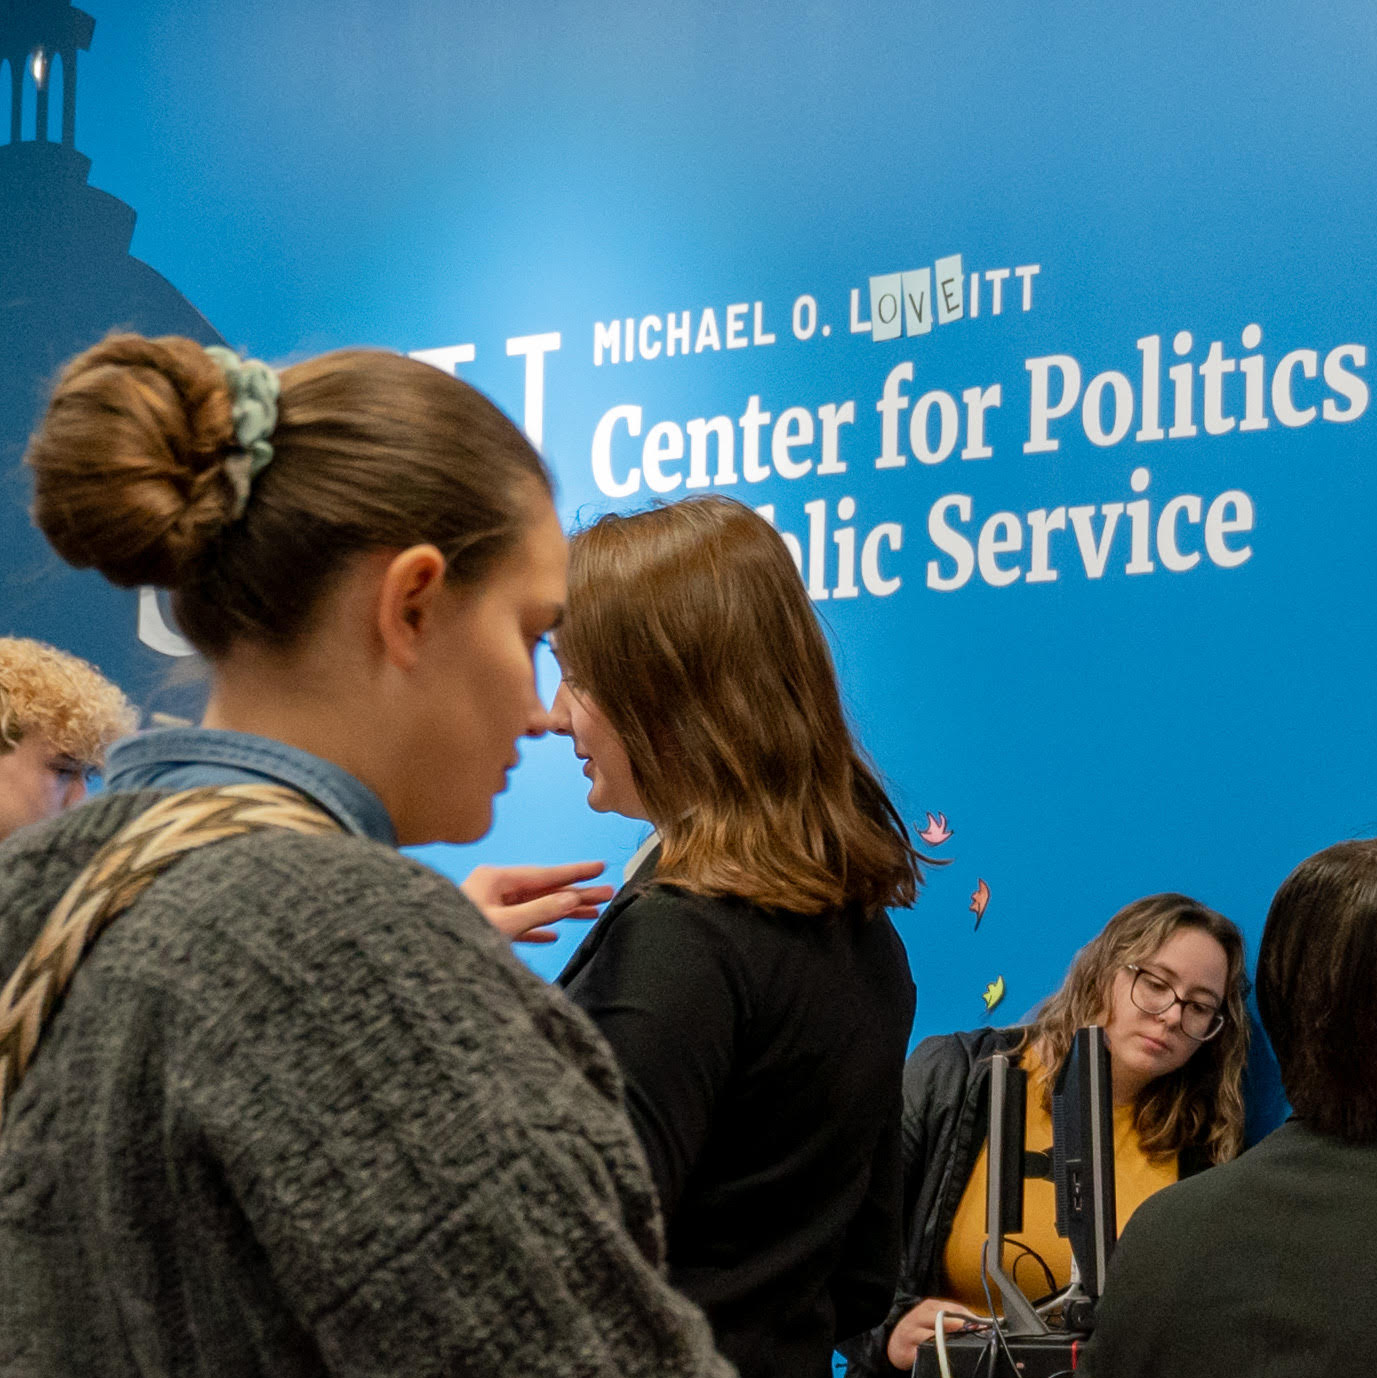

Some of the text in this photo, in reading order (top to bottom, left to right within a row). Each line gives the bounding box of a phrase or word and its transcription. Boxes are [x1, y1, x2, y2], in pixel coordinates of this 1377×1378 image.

[593, 301, 776, 366] MICHAEL
[792, 294, 831, 341] O.
[591, 322, 1369, 498] Center for Politics
[927, 467, 1254, 592] Service
